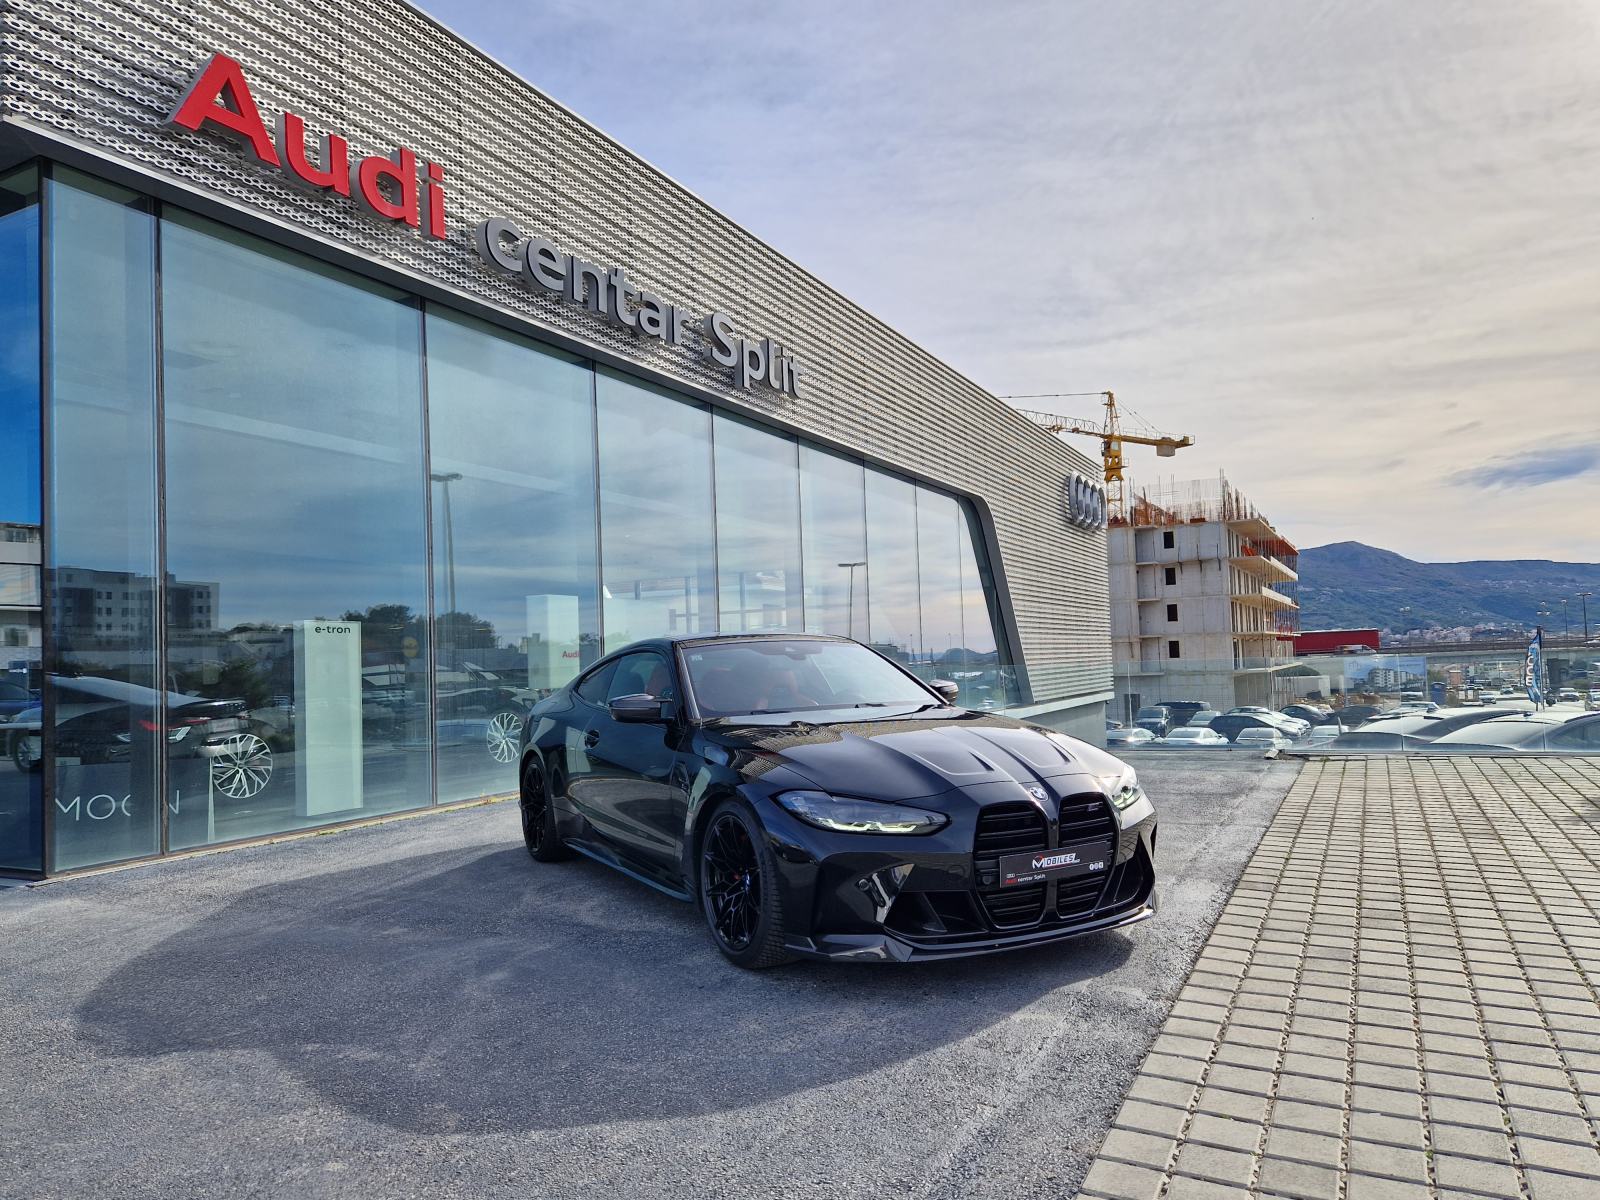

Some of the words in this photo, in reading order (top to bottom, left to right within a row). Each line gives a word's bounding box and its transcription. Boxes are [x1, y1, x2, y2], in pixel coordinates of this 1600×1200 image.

[166, 52, 446, 240] Audi
[476, 217, 690, 346] centar
[702, 312, 801, 399] Split
[314, 626, 351, 634] e-tron
